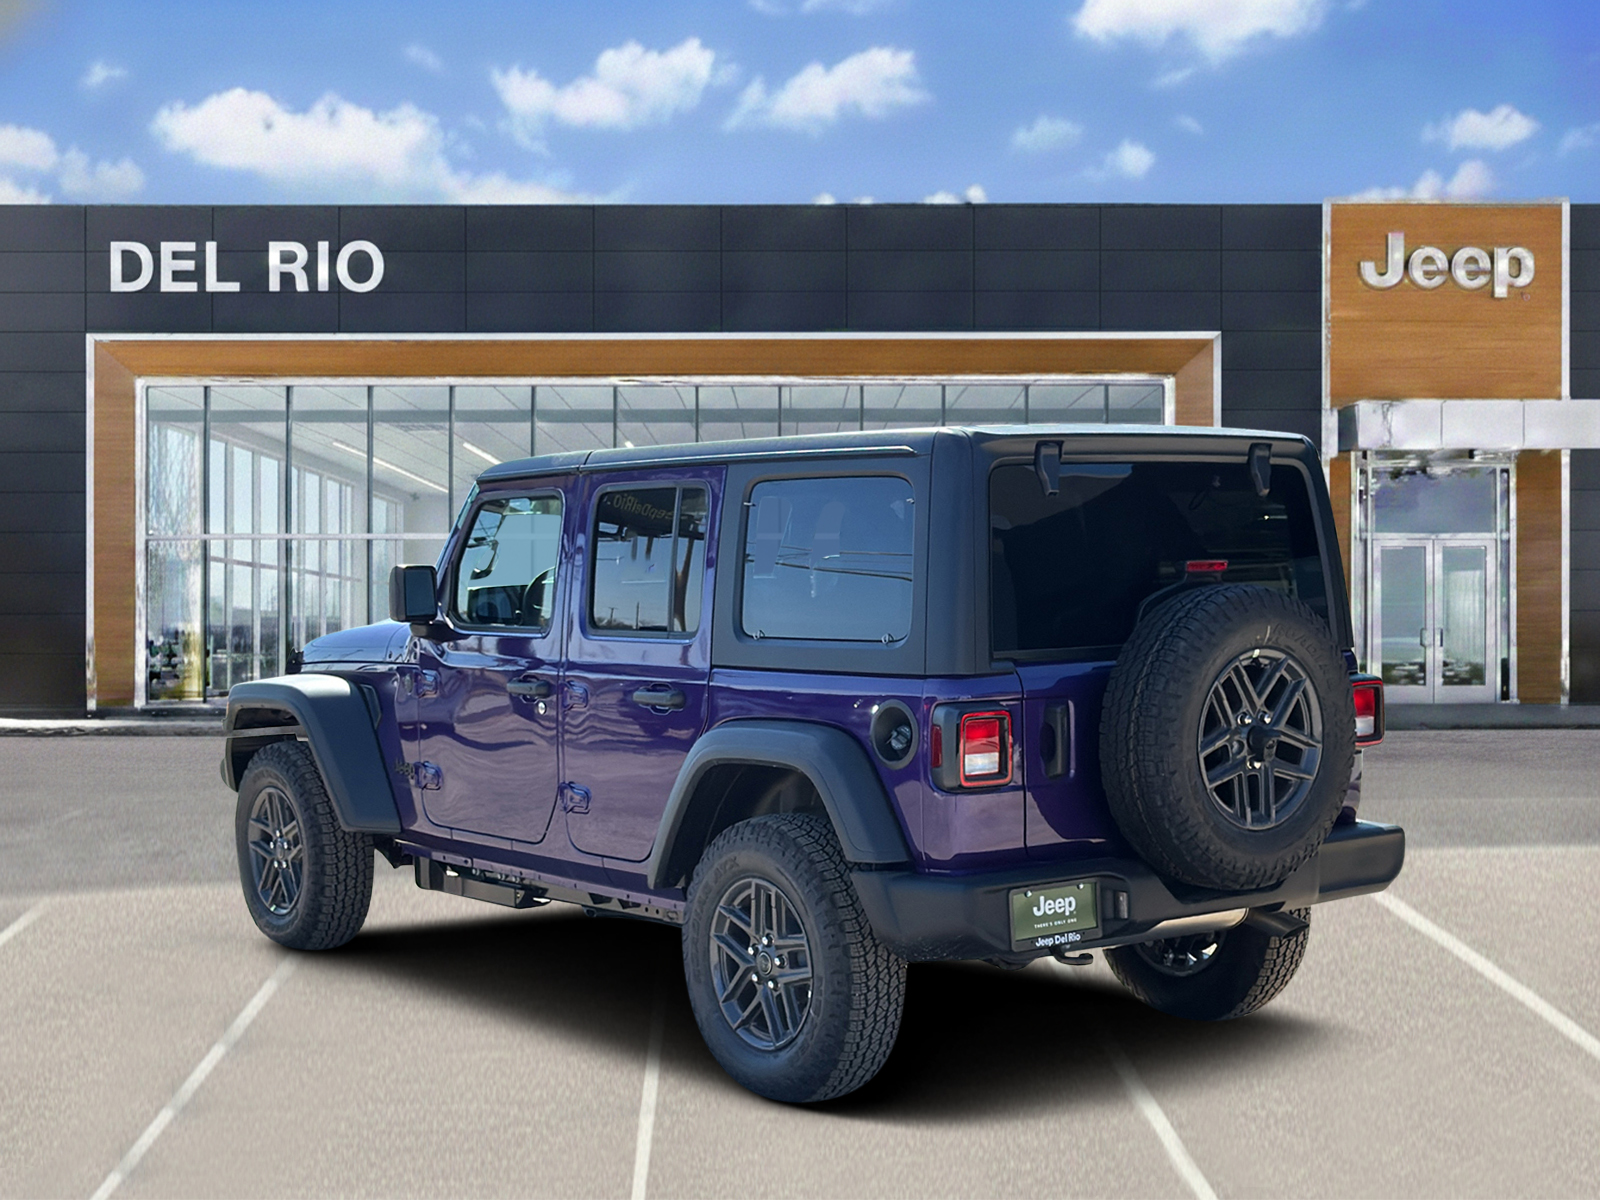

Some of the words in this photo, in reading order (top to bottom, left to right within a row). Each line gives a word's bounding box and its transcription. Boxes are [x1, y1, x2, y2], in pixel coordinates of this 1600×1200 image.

[110, 240, 241, 293] DEL
[268, 239, 385, 294] RIO
[1359, 230, 1535, 299] Jeep
[1033, 895, 1076, 917] Jeep
[1035, 936, 1054, 947] Jeep
[1054, 933, 1068, 944] Del
[1068, 931, 1081, 942] Rio
